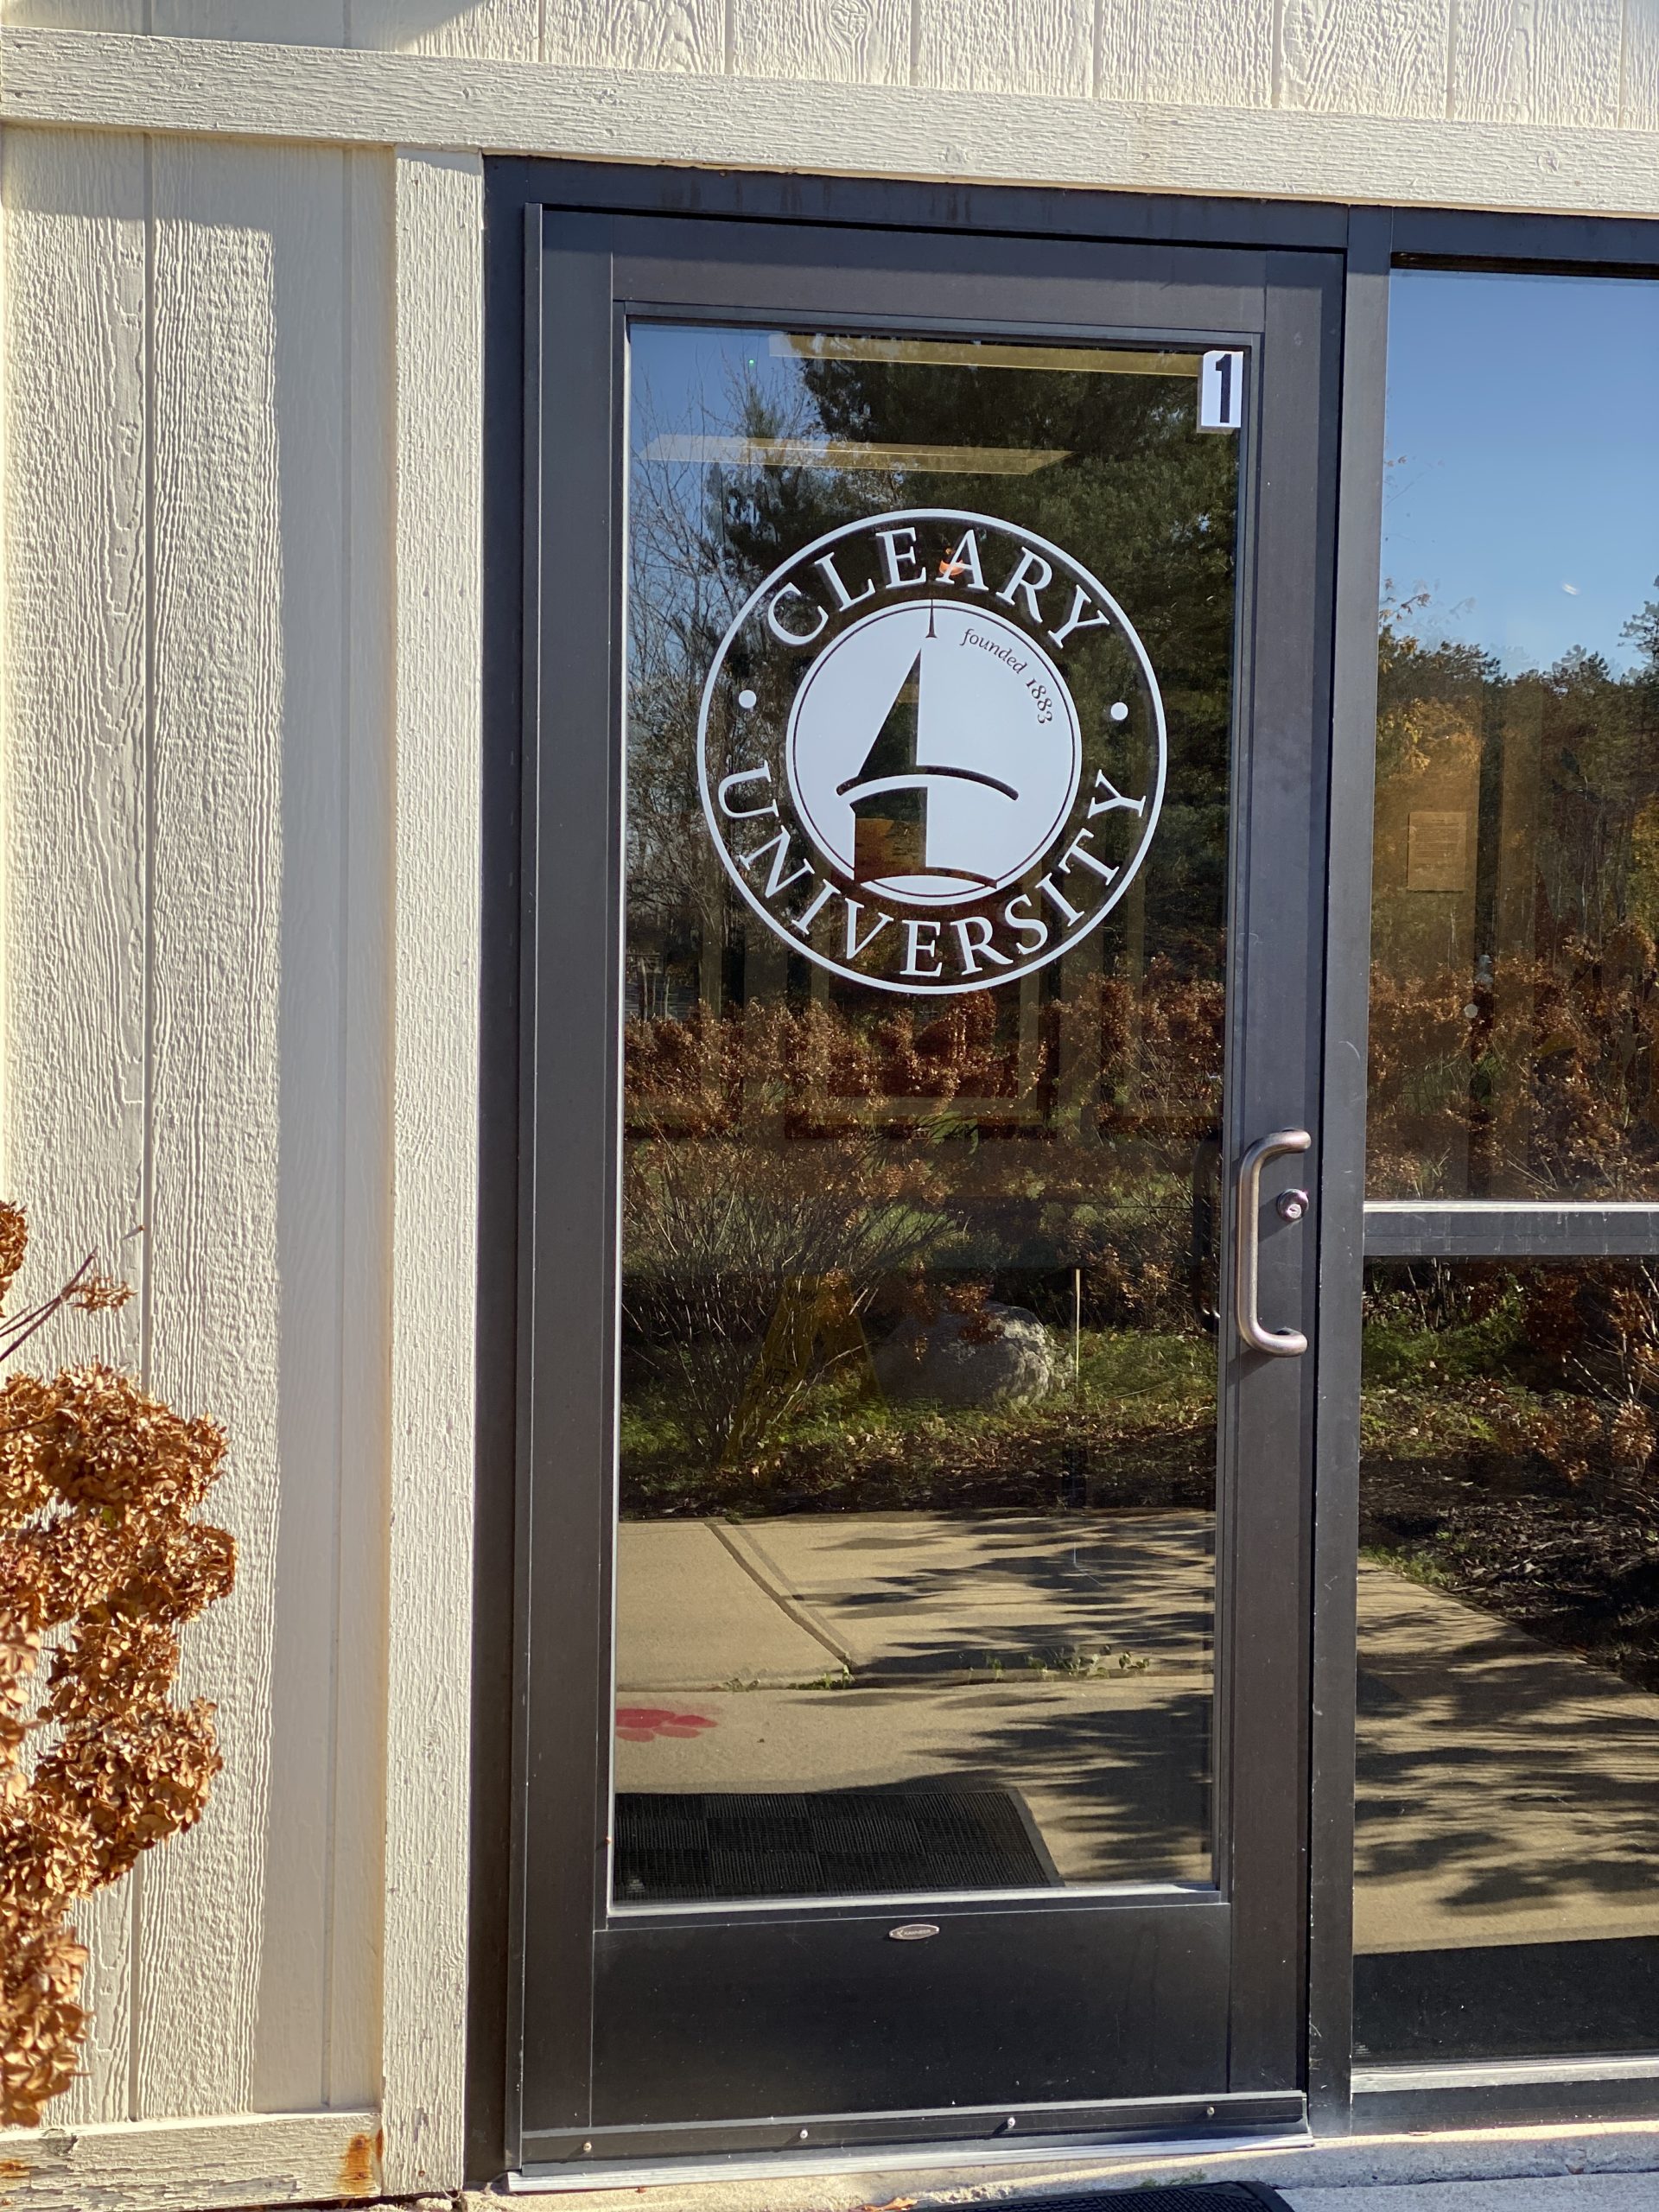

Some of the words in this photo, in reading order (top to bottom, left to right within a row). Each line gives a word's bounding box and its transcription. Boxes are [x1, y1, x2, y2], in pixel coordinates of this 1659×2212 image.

[1216, 353, 1232, 423] 1
[766, 526, 1110, 648] CLEARY
[959, 628, 1027, 675] founded
[1026, 677, 1052, 724] 1883
[717, 760, 1147, 977] UNIVERSITY
